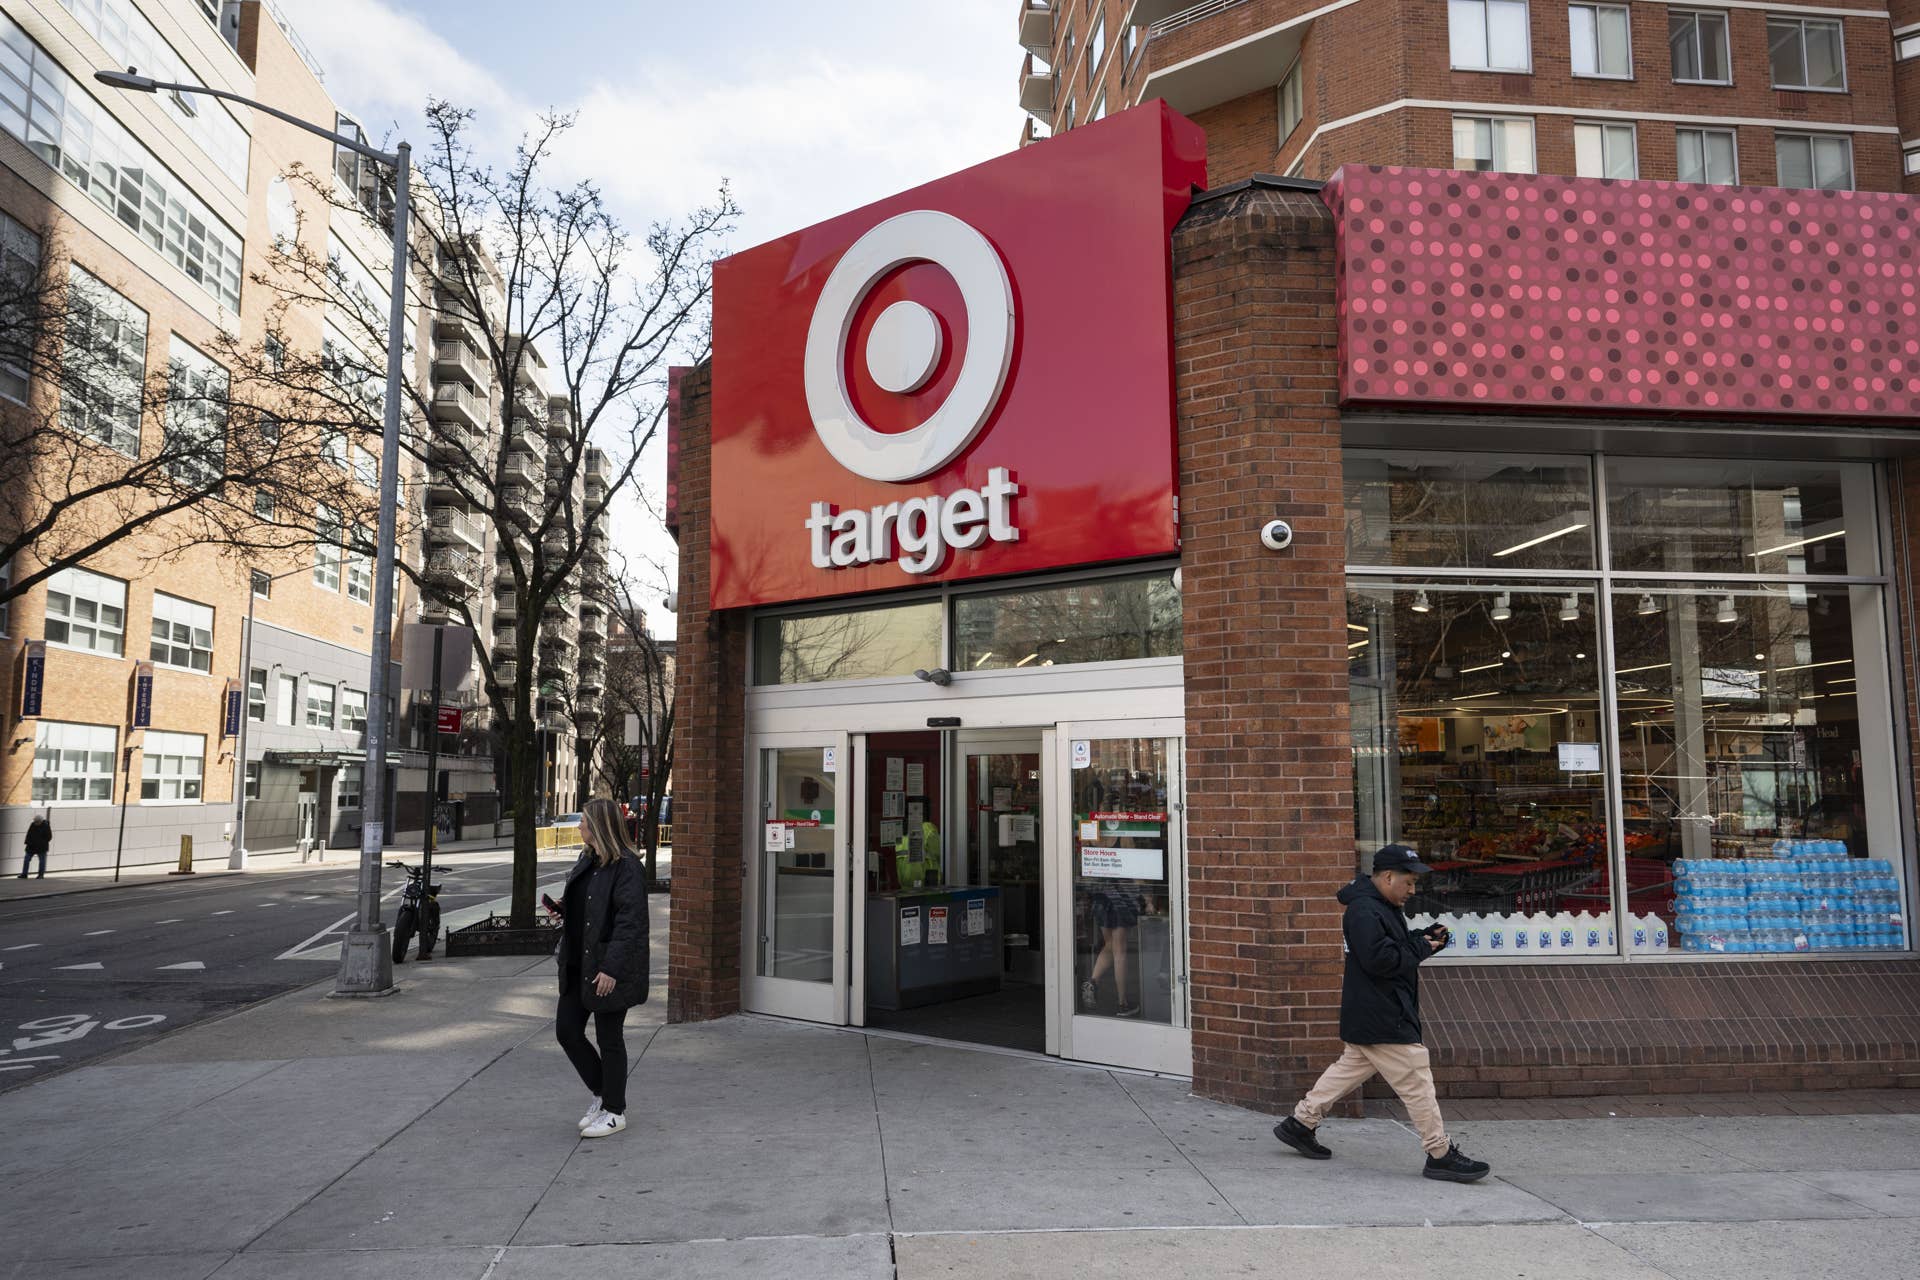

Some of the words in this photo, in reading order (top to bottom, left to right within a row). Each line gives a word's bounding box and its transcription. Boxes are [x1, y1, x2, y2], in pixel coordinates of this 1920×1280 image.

[805, 466, 1020, 575] target
[29, 659, 39, 713] KINDNESS
[140, 677, 148, 724] INTEGRITY
[1100, 849, 1117, 857] Hours
